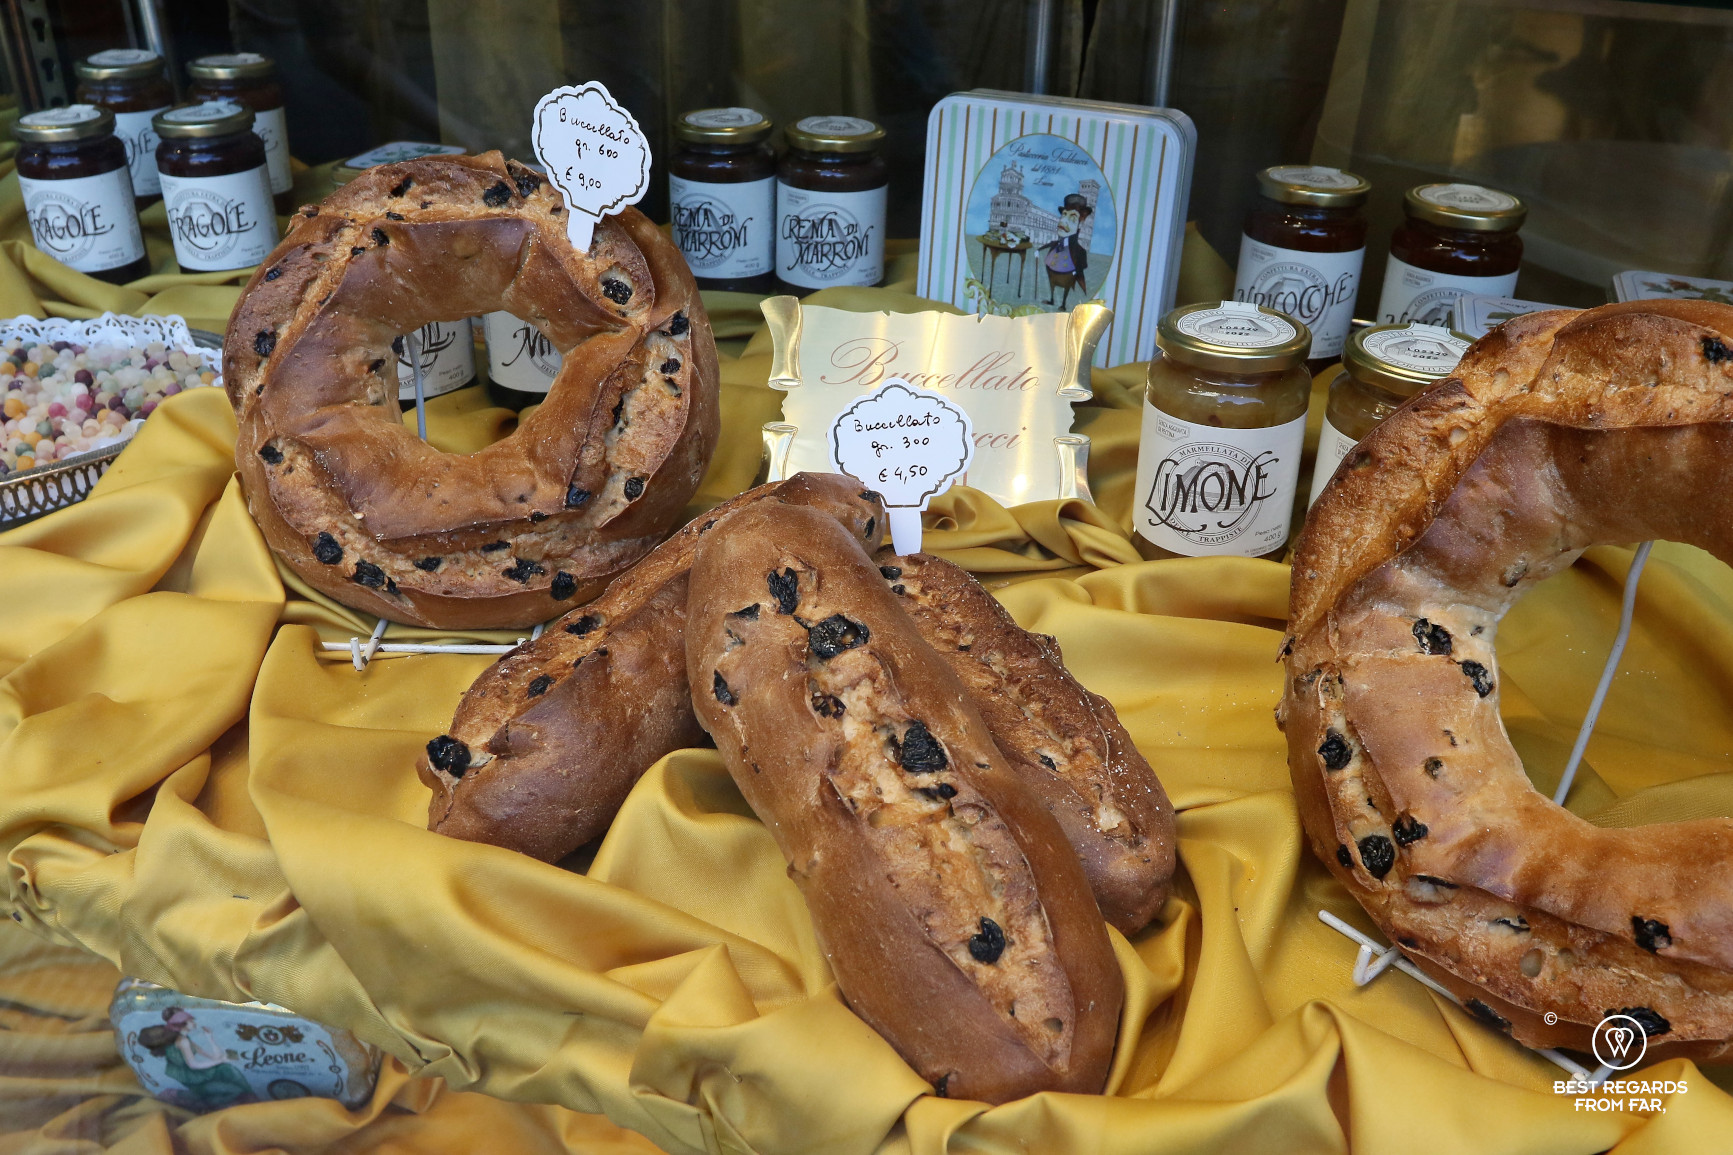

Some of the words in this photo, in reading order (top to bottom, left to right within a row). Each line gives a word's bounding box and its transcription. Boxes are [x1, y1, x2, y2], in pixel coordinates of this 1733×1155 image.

[598, 143, 619, 159] 600
[578, 172, 602, 191] 9,00
[168, 198, 257, 251] FRAGOLE
[671, 201, 713, 233] REMA
[782, 211, 838, 245] CREMA
[844, 223, 859, 237] DI
[786, 225, 875, 272] MARRONI
[819, 336, 1042, 393] Buccellato
[854, 412, 941, 432] Buccellato
[902, 436, 931, 449] 300
[1179, 445, 1239, 459] MARMELLATA
[1240, 456, 1251, 466] DI
[894, 465, 928, 485] 4,50
[1145, 450, 1280, 533] LIMONE
[1199, 526, 1243, 543] TRAPPISTE
[240, 1047, 315, 1070] Leone
